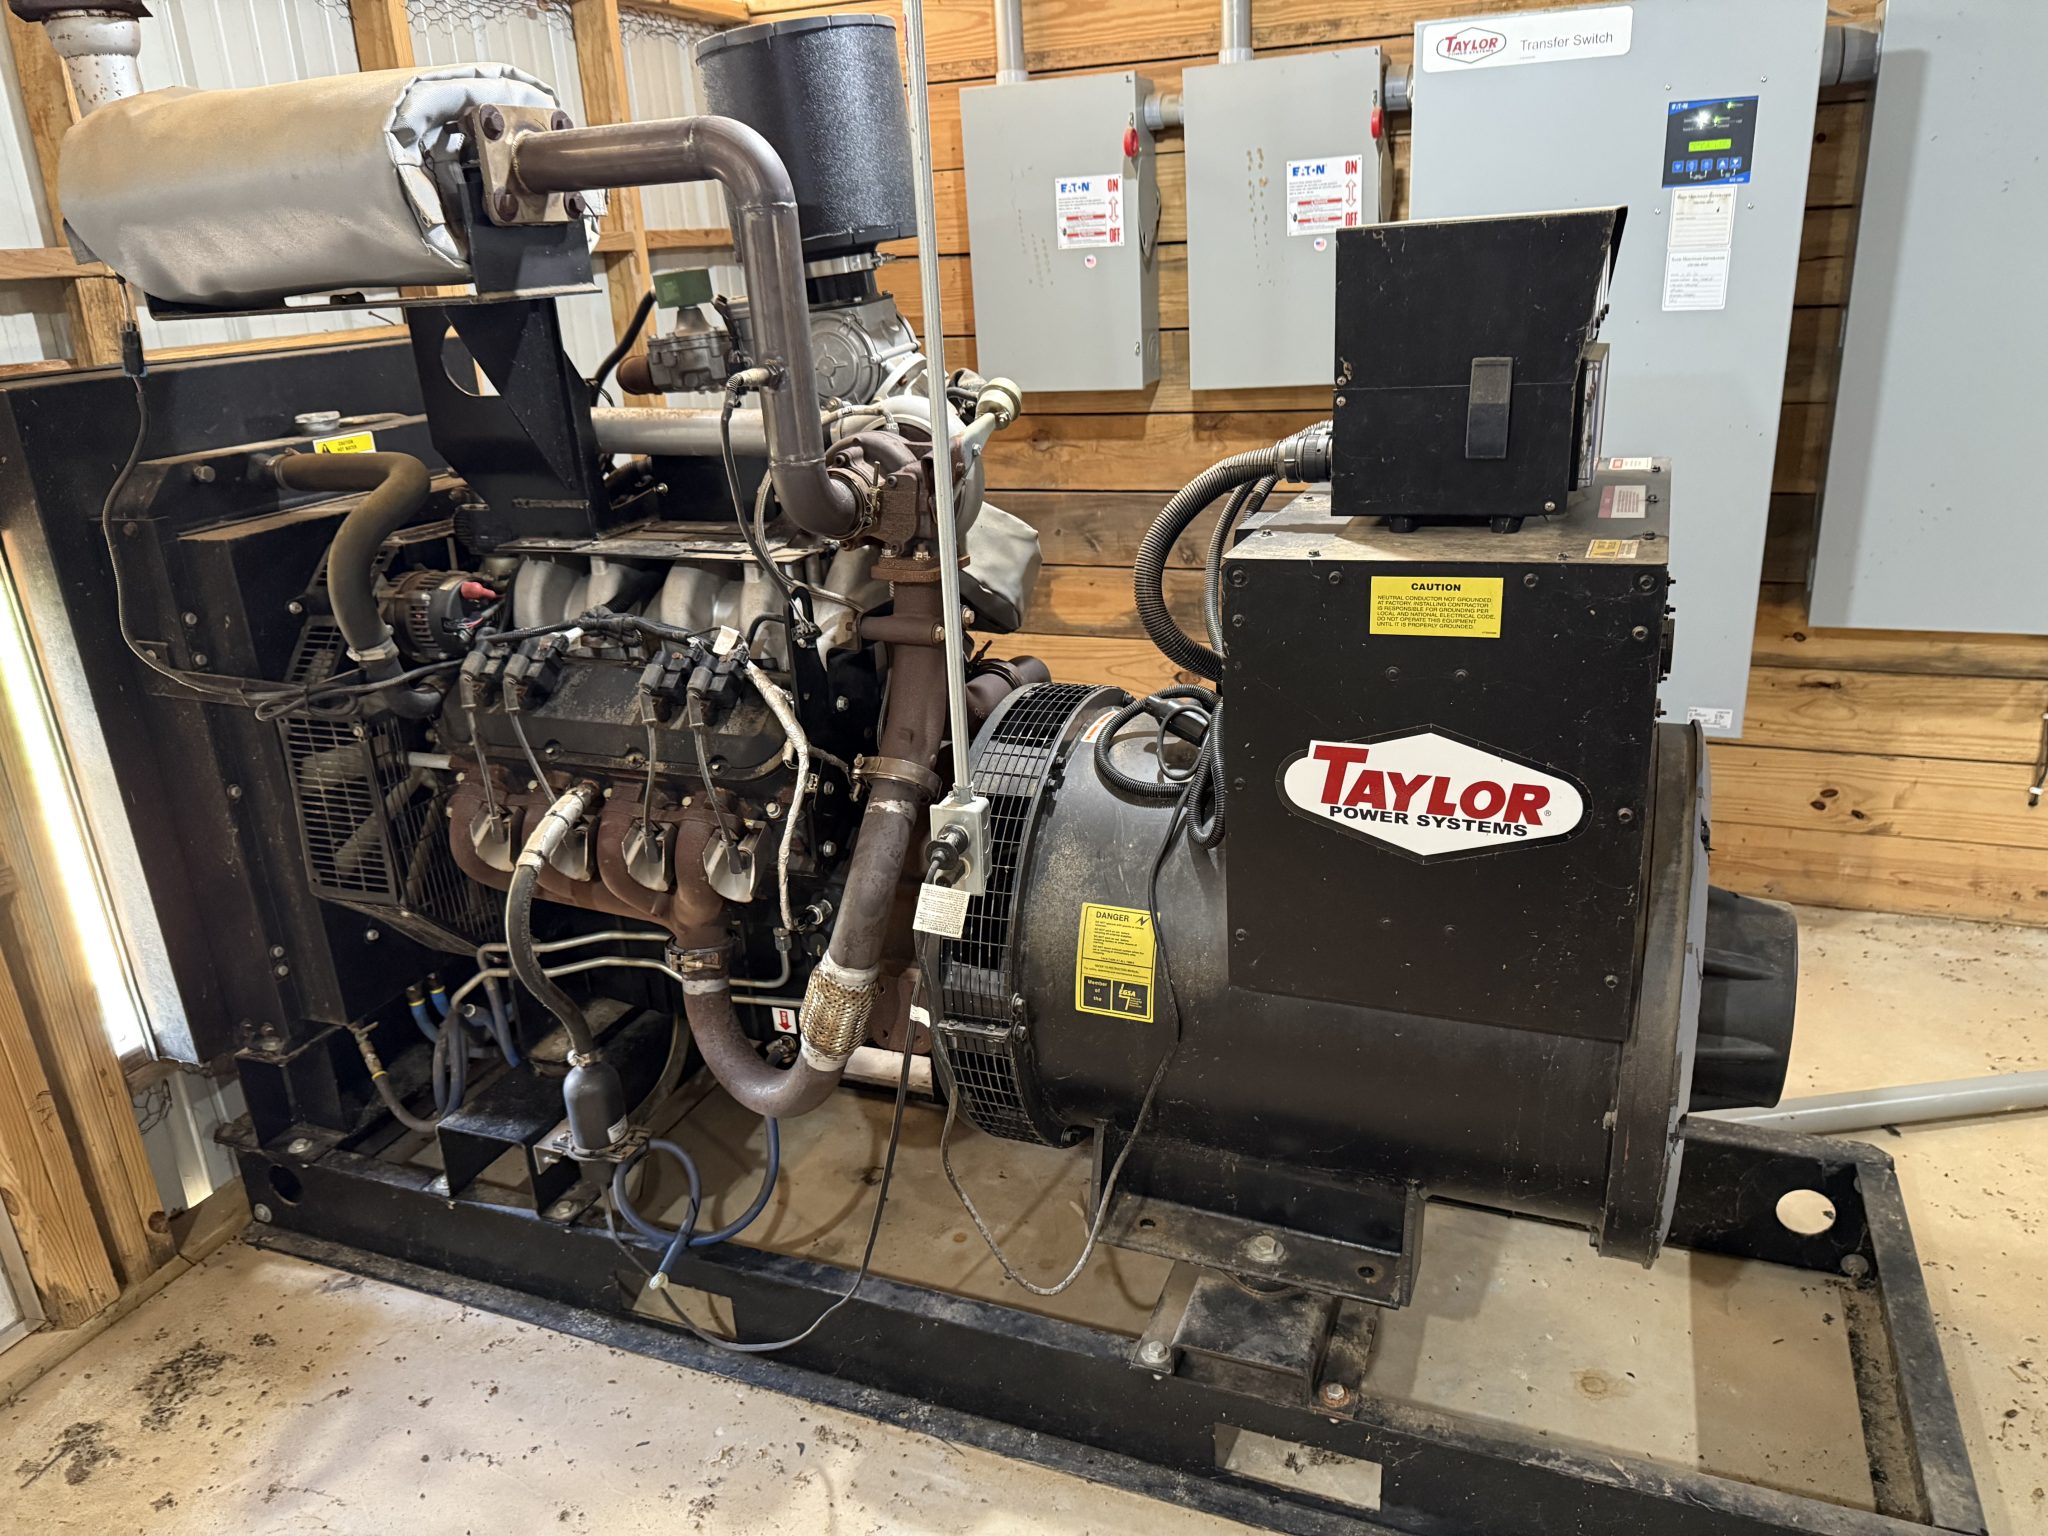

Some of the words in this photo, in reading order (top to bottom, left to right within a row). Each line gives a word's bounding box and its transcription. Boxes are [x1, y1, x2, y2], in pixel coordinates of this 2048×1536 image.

[1445, 36, 1498, 53] TAYLOR
[1520, 36, 1569, 51] Transfer
[1573, 32, 1613, 46] Switch
[1292, 164, 1325, 177] EATON
[1345, 159, 1358, 175] ON
[1060, 181, 1090, 193] EATON
[1107, 178, 1119, 192] ON
[1345, 211, 1358, 227] OFF
[1109, 227, 1121, 243] OFF
[1411, 582, 1461, 592] CAUTION
[1313, 744, 1551, 826] TAYLOR
[1329, 805, 1409, 825] POWER
[1416, 814, 1528, 837] SYSTEMS
[1095, 911, 1130, 922] DANGER
[1087, 979, 1108, 987] Member
